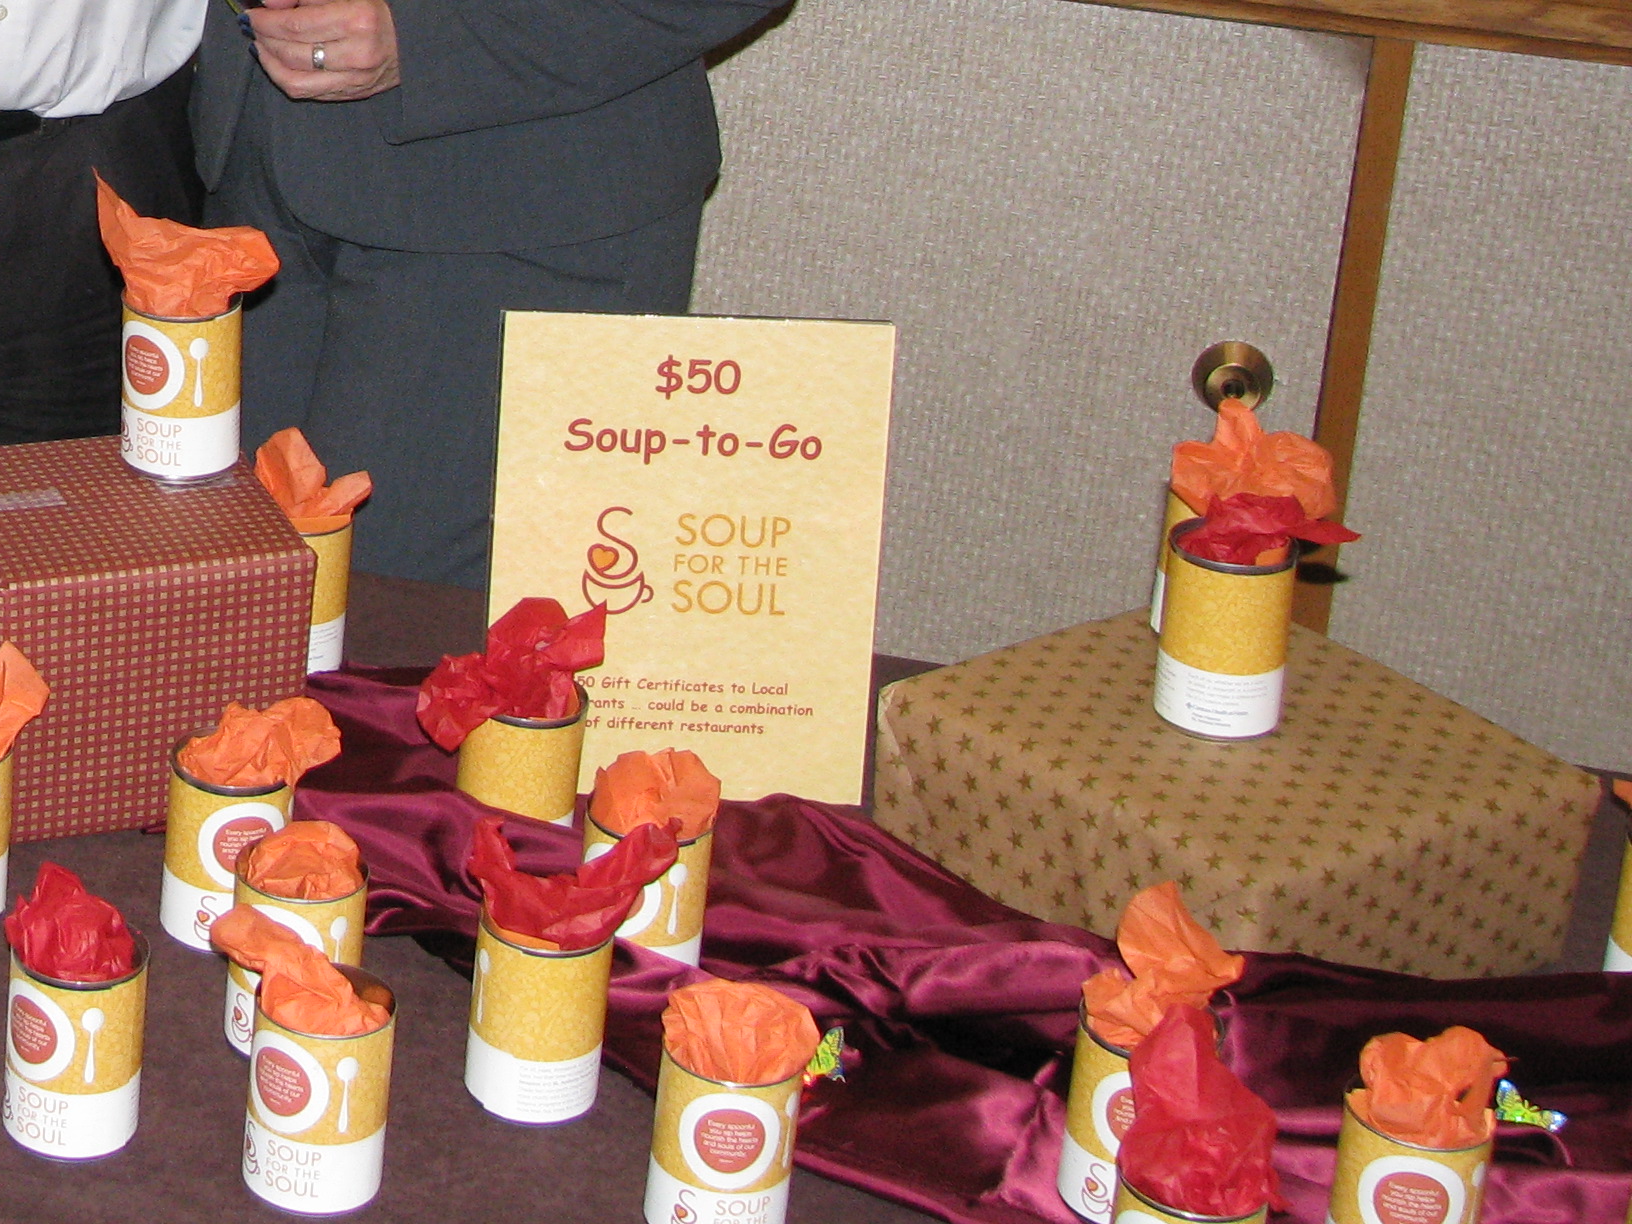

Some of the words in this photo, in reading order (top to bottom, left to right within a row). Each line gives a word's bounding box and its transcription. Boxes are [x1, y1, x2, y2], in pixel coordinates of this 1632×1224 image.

[656, 354, 741, 399] $50
[137, 418, 182, 438] SOUP
[564, 418, 823, 465] Soup-to-Go
[137, 445, 182, 466] SOUL
[675, 513, 791, 548] SOUP
[673, 553, 724, 575] FOR
[739, 556, 787, 577] THE
[671, 579, 785, 616] SOUL
[576, 676, 595, 688] 50
[602, 677, 631, 689] Gift
[637, 678, 724, 694] Certificates
[731, 683, 745, 694] to
[752, 683, 788, 695] Local
[648, 700, 684, 712] could
[691, 700, 708, 712] be
[715, 705, 723, 713] a
[730, 703, 813, 716] combination
[585, 716, 600, 728] of
[607, 717, 673, 730] different
[681, 722, 764, 734] restaurants
[18, 1086, 68, 1115] SOUP
[17, 1116, 66, 1146] SOUL
[267, 1140, 322, 1167] SOUP
[265, 1170, 318, 1198] SOUL
[715, 1196, 770, 1216] SOUP
